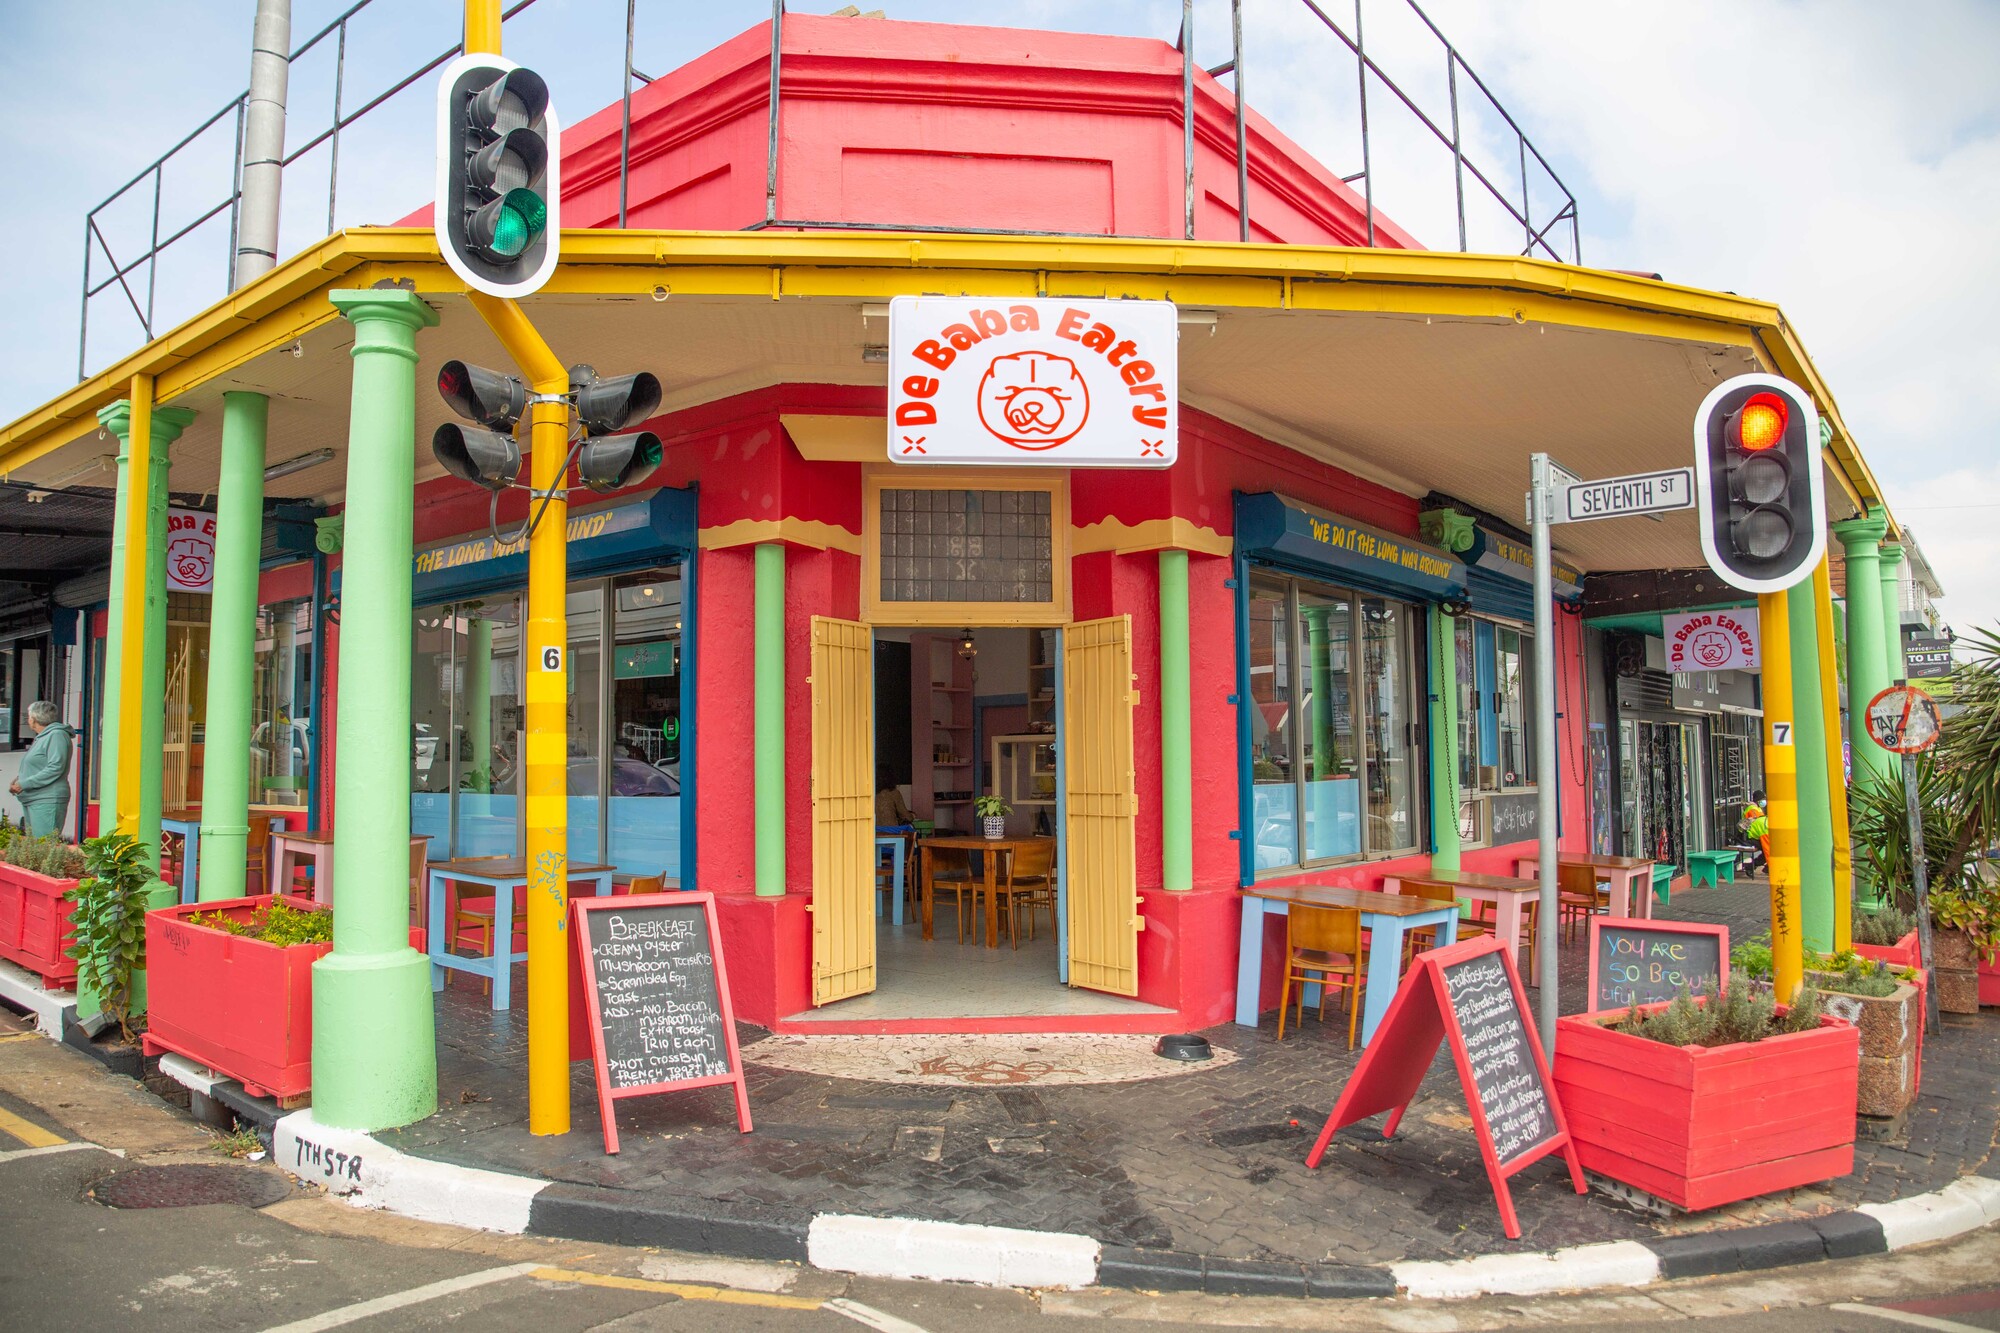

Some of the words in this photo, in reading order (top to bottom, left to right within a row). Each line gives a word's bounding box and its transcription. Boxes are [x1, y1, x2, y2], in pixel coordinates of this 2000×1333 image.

[912, 304, 1040, 372] Baba
[1055, 307, 1168, 430] Eatery
[895, 374, 940, 427] De
[1582, 481, 1653, 513] SEVENTH
[1660, 478, 1675, 493] ST
[416, 550, 446, 574] THE
[447, 542, 486, 568] LONG
[1332, 525, 1345, 548] DO
[1346, 529, 1357, 551] IT
[1357, 533, 1376, 557] THE
[1377, 540, 1399, 563] LONG
[1401, 549, 1419, 571] WAY
[1674, 614, 1712, 642] Baba
[1716, 614, 1754, 657] Eatery
[544, 648, 560, 670] 6
[1671, 643, 1684, 662] De
[1908, 654, 1924, 663] TO
[1926, 653, 1949, 662] LET
[1773, 724, 1790, 743] 7
[609, 915, 695, 936] BREAKFAST
[669, 971, 687, 988] Egg
[604, 991, 640, 1004] Toast
[615, 1068, 663, 1081] FRENCH
[619, 1058, 644, 1070] HOT
[295, 1135, 321, 1167] 7TH
[324, 1147, 363, 1182] STR
